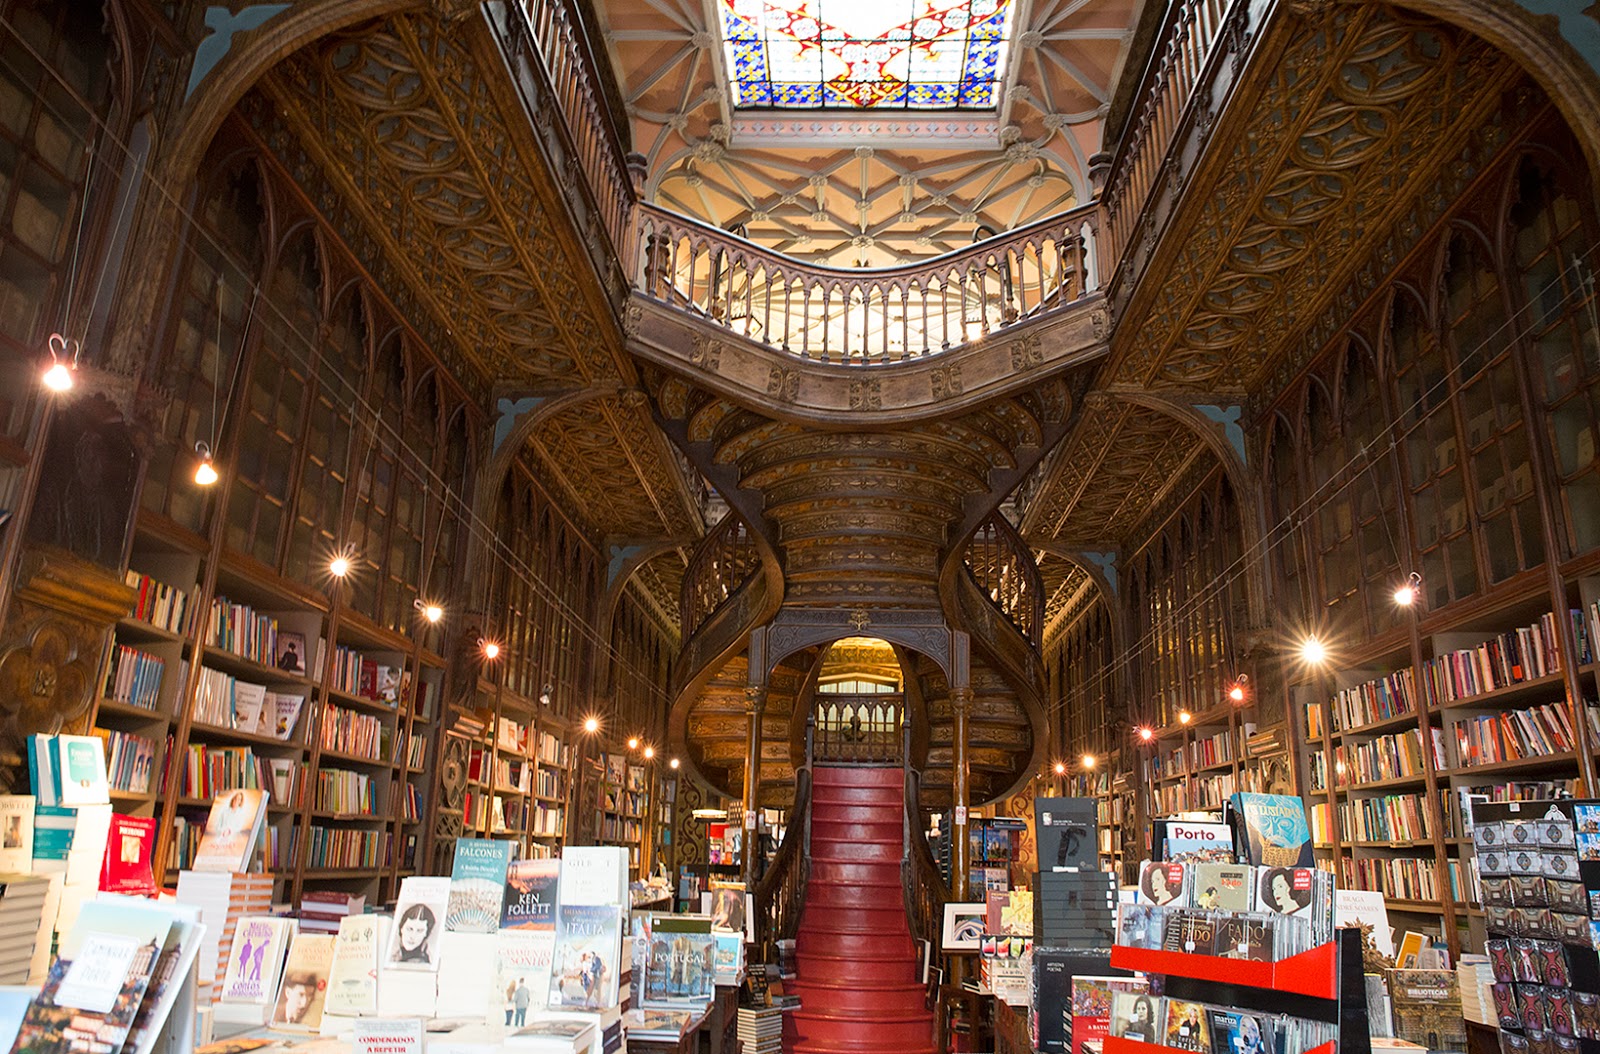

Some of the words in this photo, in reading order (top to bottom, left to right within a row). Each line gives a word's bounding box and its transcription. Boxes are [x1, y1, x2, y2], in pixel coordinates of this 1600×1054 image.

[1175, 827, 1215, 840] Porto
[460, 846, 503, 859] FALCONES
[519, 893, 540, 904] KEN
[508, 903, 551, 916] FOLLETT
[655, 952, 707, 963] PORTUGAL
[1214, 1014, 1238, 1026] mariza
[358, 1036, 416, 1044] CONDENADOS
[1169, 1039, 1204, 1053] mariza
